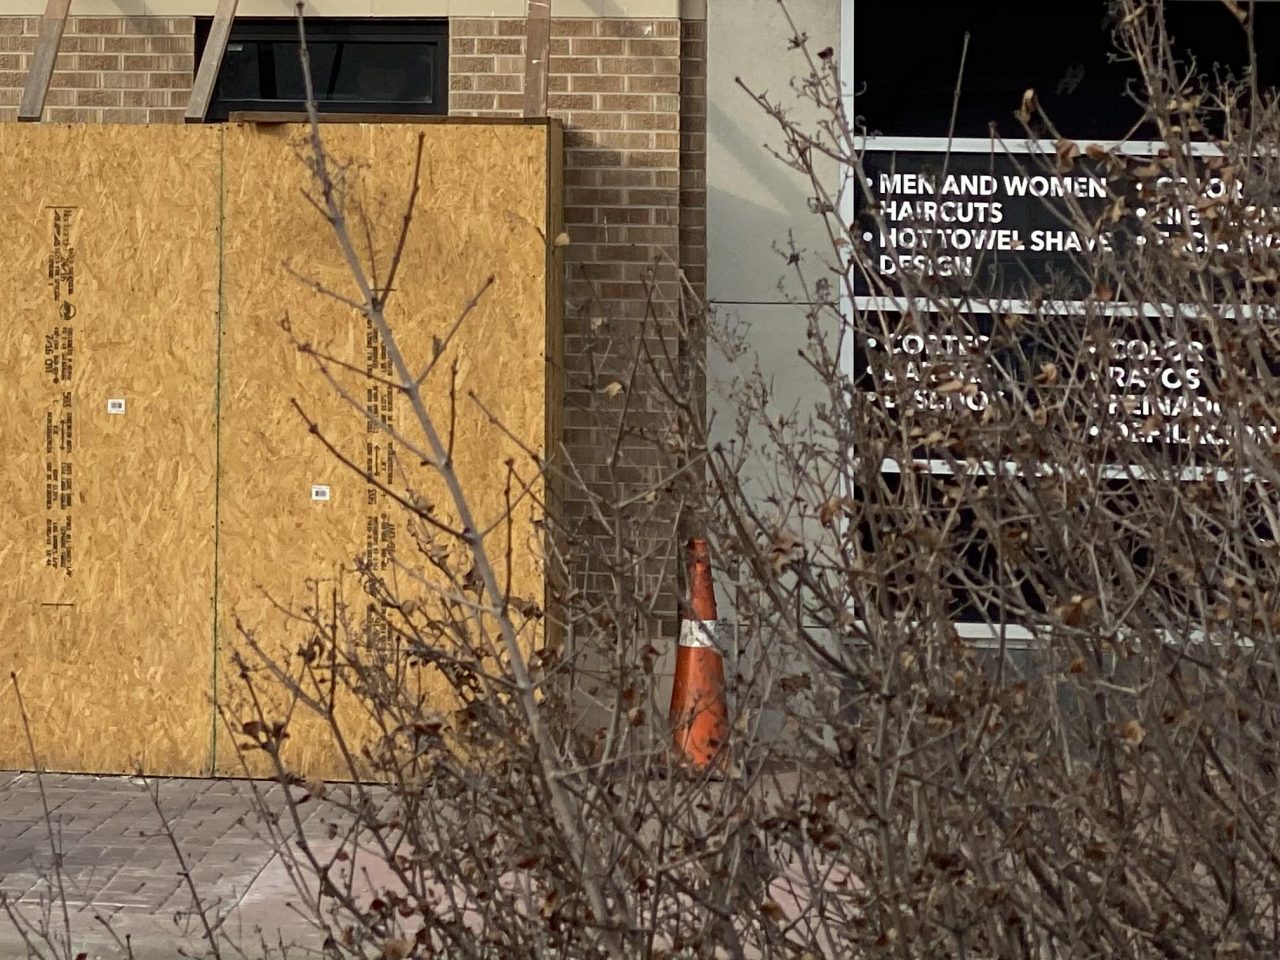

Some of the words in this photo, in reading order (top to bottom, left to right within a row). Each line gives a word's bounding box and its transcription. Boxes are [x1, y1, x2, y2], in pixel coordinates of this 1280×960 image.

[879, 173, 935, 195] MEN
[942, 174, 998, 196] AND
[1003, 175, 1107, 198] WOMEN
[879, 200, 1004, 223] HAIRCUTS
[879, 227, 933, 249] HOT
[936, 228, 1026, 251] TOWEL
[879, 254, 973, 277] DESIGN
